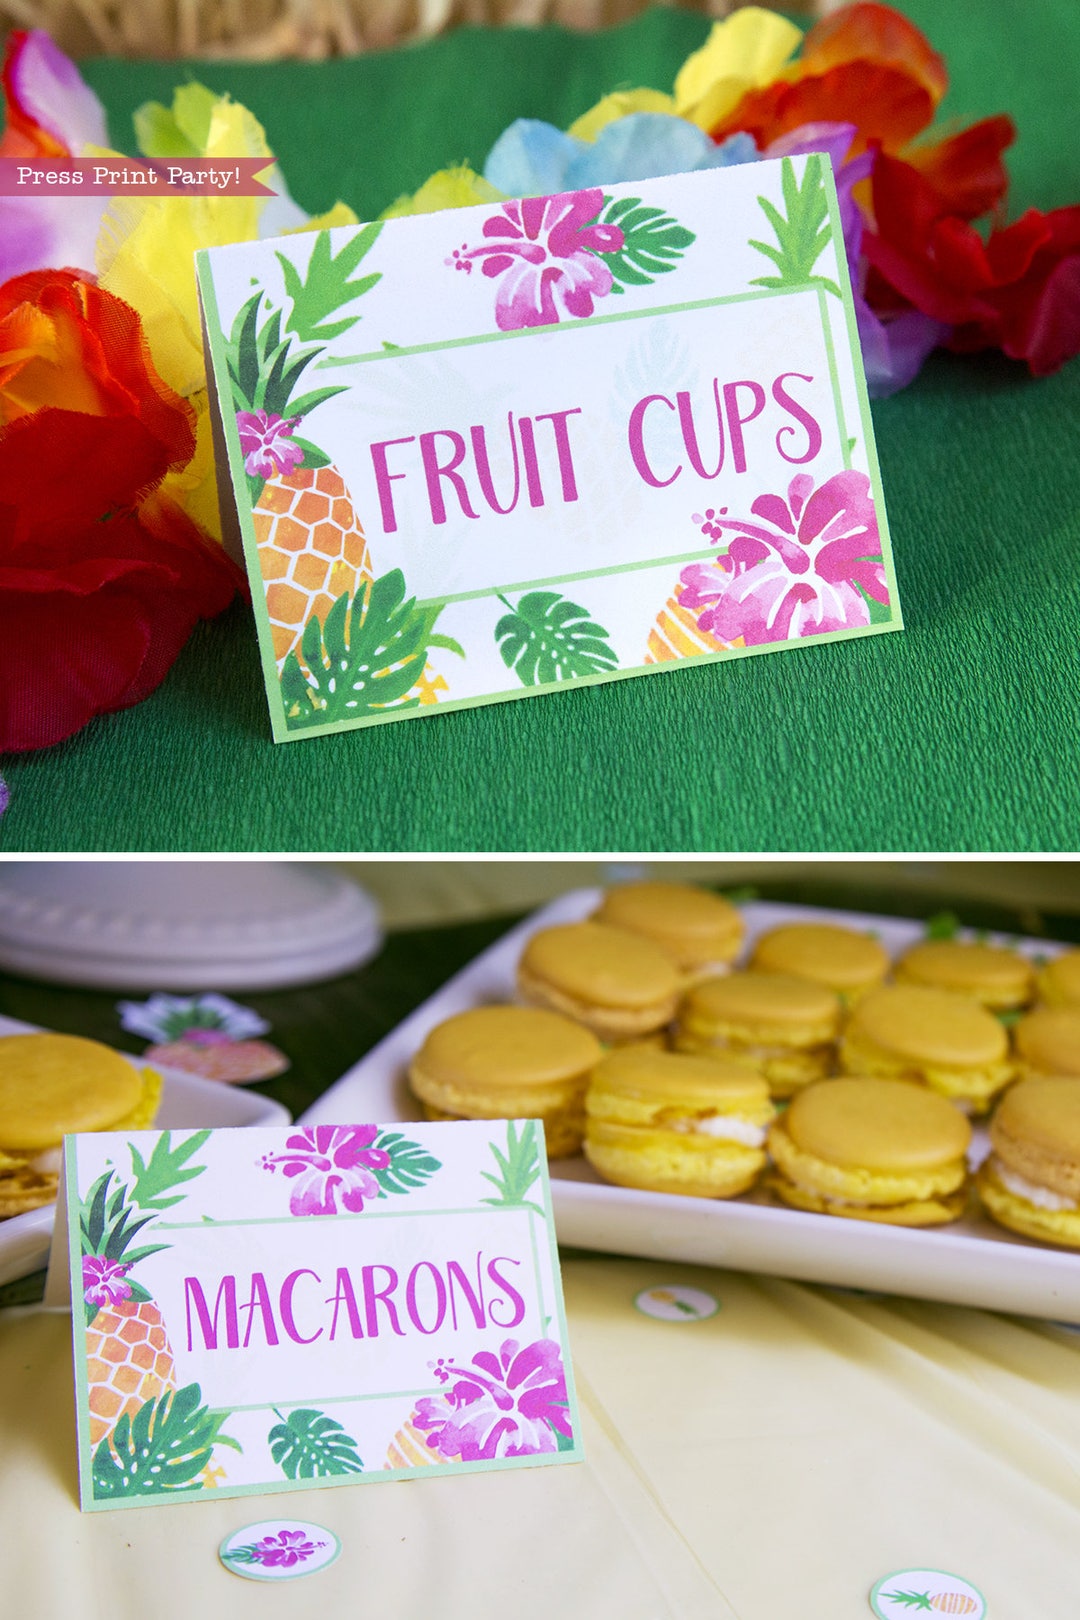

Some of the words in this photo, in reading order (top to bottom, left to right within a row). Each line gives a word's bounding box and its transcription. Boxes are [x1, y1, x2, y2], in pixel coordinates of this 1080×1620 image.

[370, 407, 582, 533] FRUIT
[628, 372, 823, 488] CUPS
[184, 1251, 526, 1352] MACARONS
